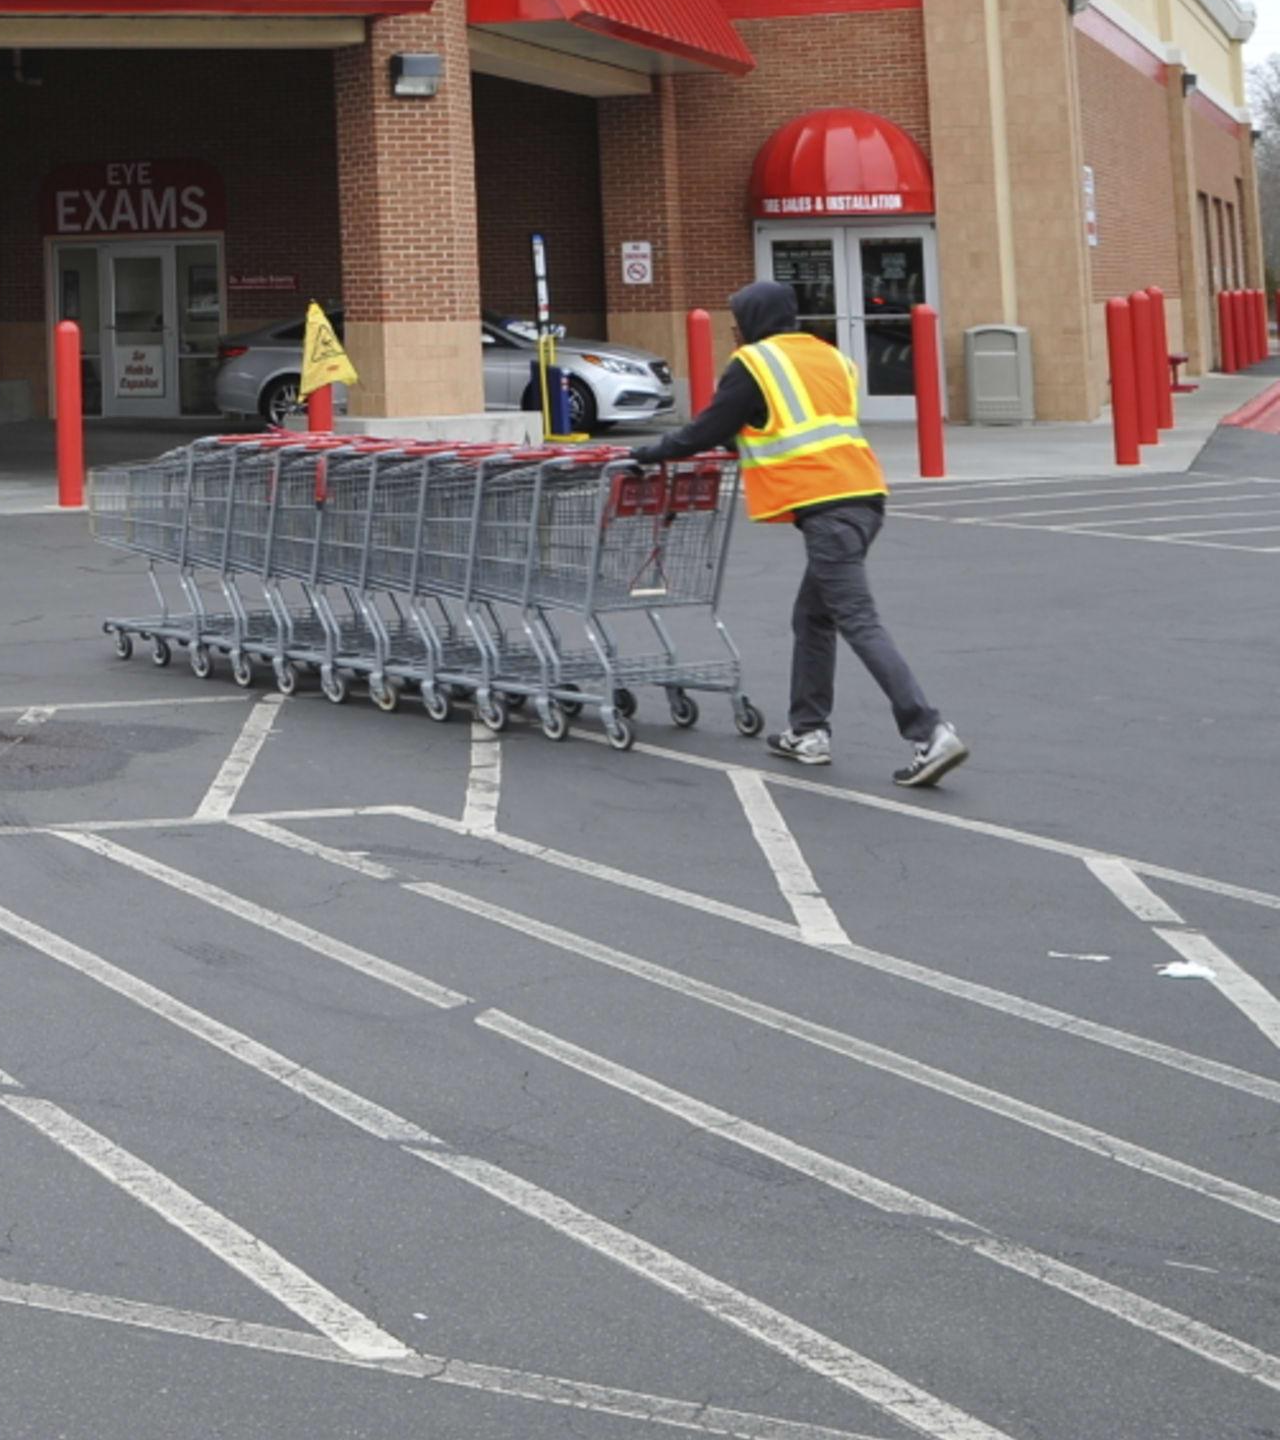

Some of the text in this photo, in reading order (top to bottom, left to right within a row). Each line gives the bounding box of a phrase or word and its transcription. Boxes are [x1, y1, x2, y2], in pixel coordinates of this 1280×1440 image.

[107, 163, 152, 185] EYE
[56, 186, 208, 232] EXAMS
[763, 198, 781, 213] TIRE
[782, 196, 812, 212] SALES
[826, 194, 903, 210] INSTALLATION
